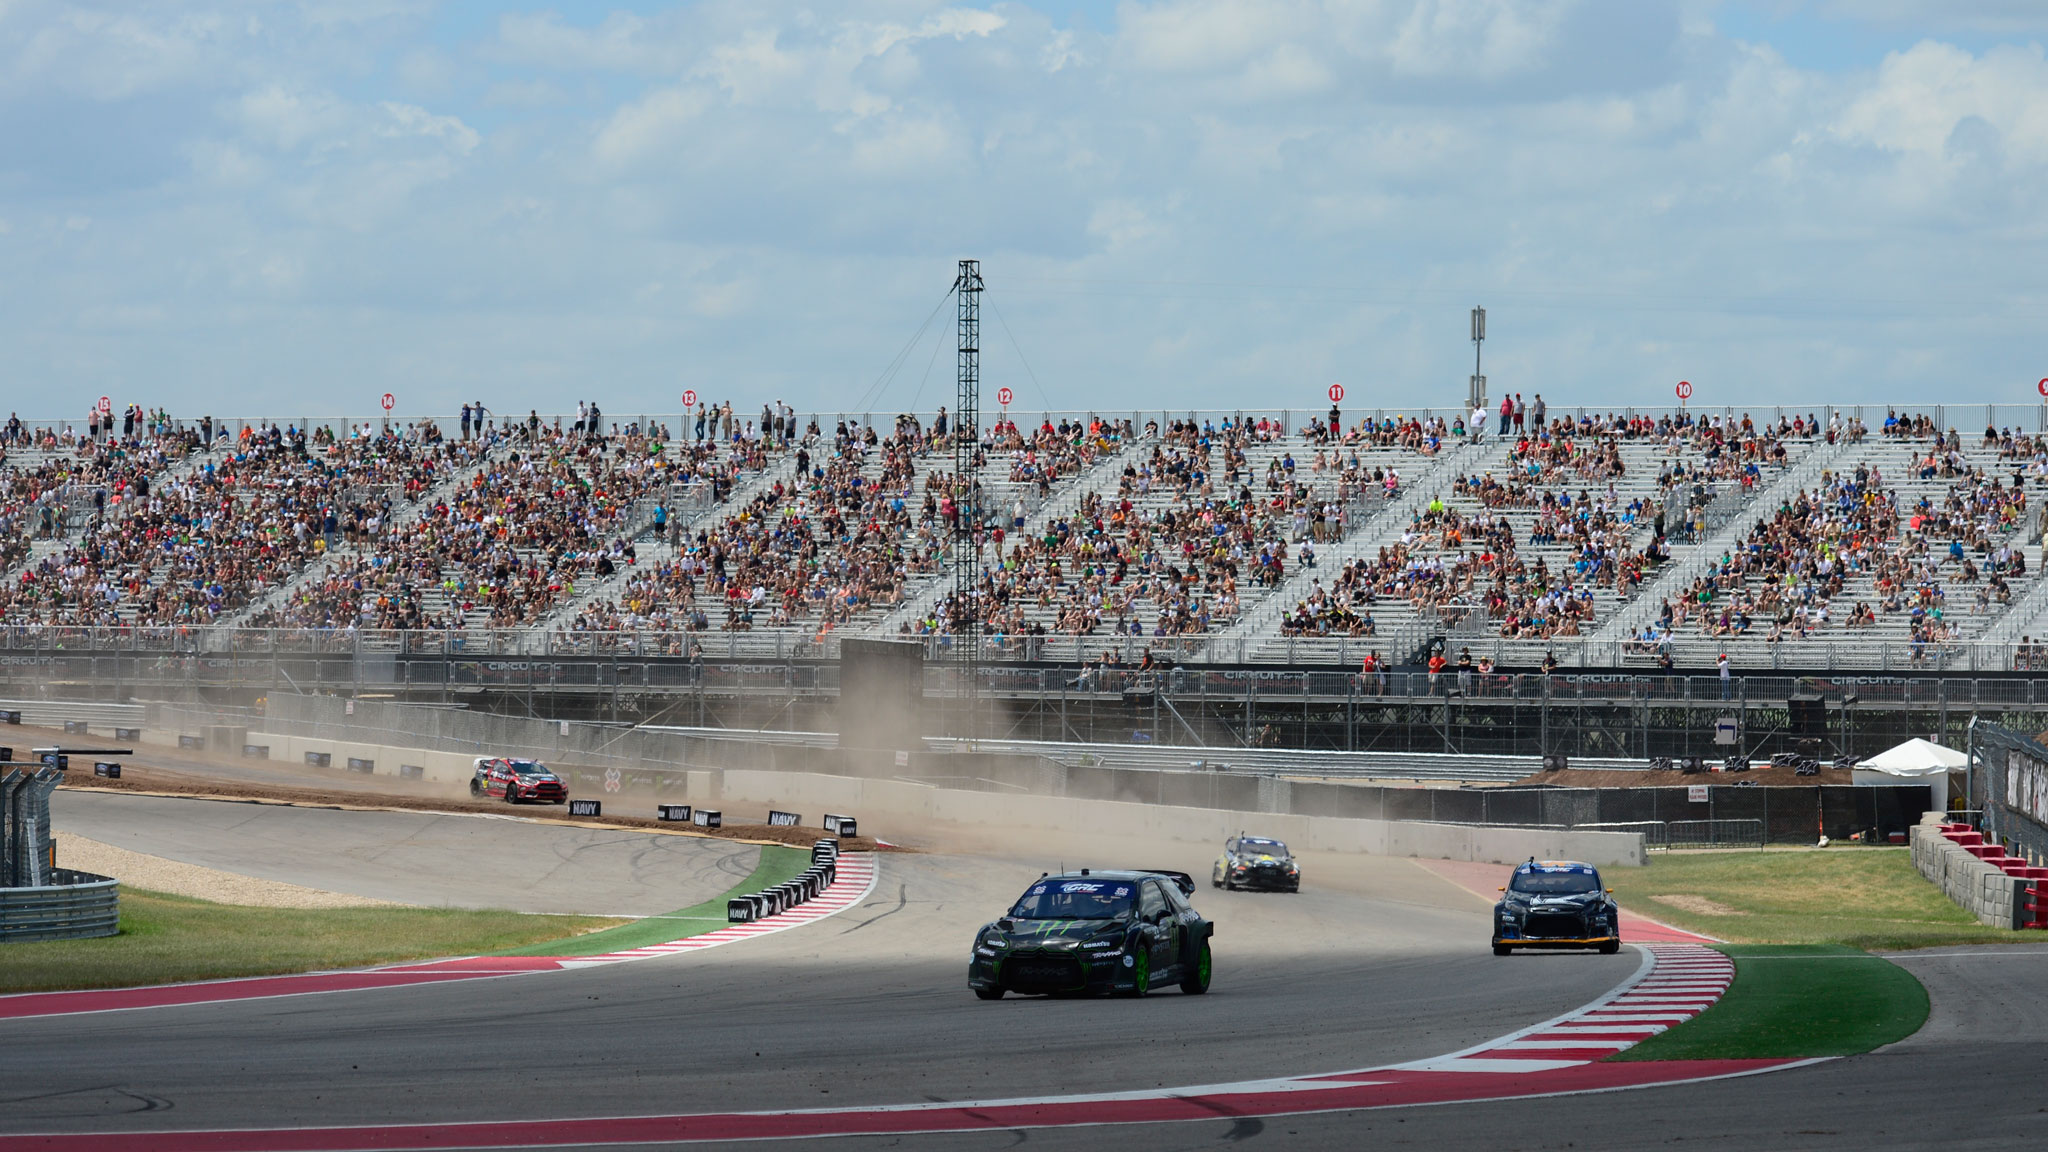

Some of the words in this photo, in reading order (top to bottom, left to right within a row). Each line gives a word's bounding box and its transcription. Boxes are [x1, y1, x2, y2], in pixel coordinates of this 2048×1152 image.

[1330, 387, 1342, 399] 11
[1678, 384, 1690, 396] 10
[383, 396, 393, 407] 14
[684, 393, 695, 404] 13
[999, 390, 1011, 402] 12
[99, 399, 109, 410] 15
[1, 657, 49, 665] CRCUT
[208, 660, 257, 668] CIRUIT
[488, 662, 540, 671] CIRCUT
[1566, 674, 1624, 683] CRCUIT
[1831, 676, 1894, 685] CIRCUIT
[572, 801, 597, 815] NAVY
[669, 806, 689, 820] NAVY
[771, 812, 797, 826] NAVY
[825, 816, 836, 830] NA
[729, 907, 749, 919] NAVY
